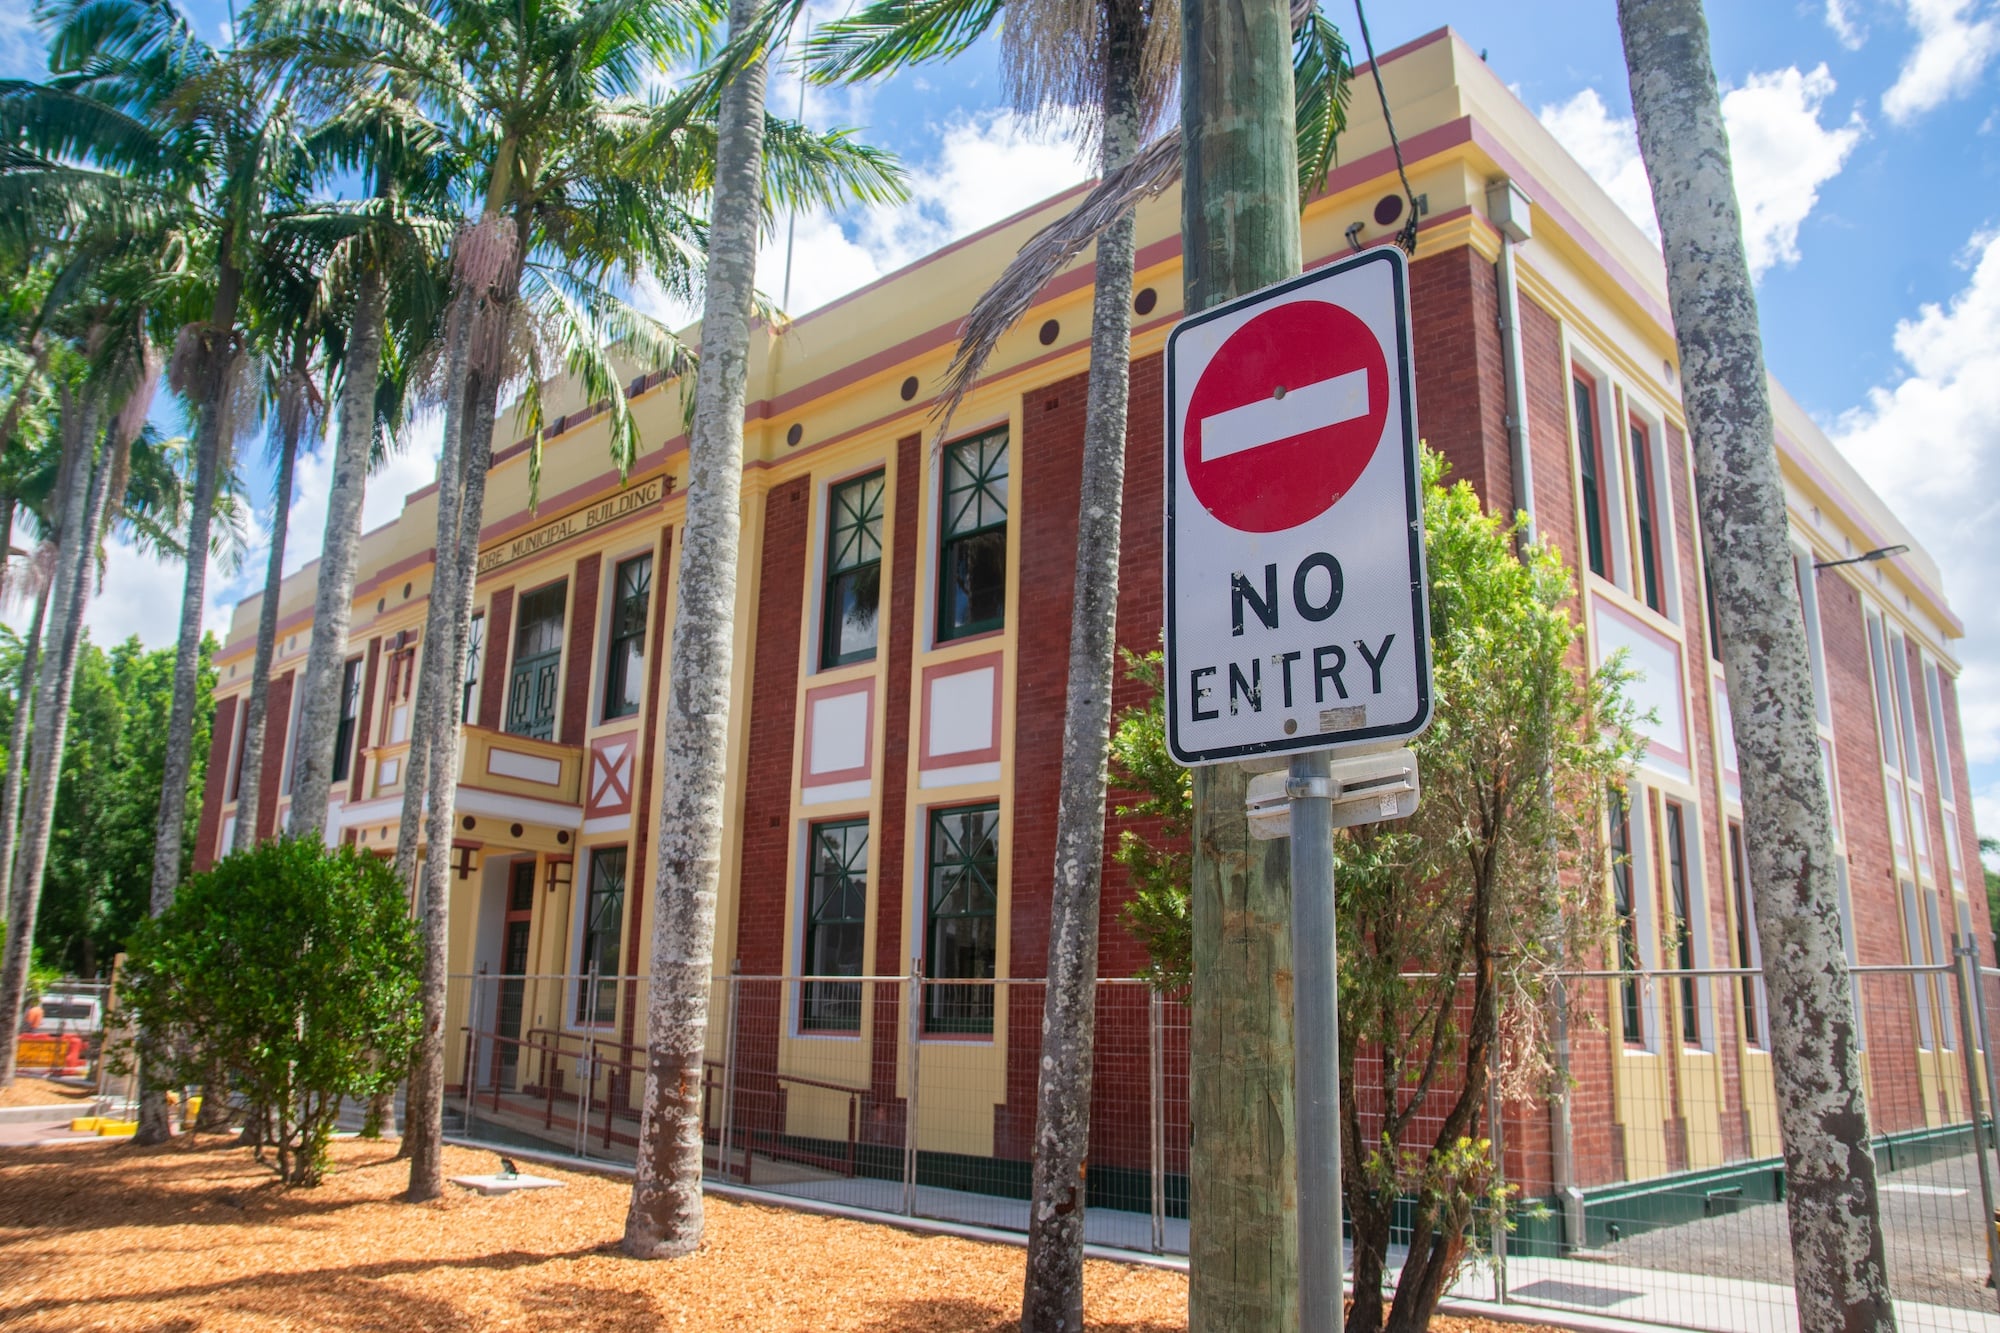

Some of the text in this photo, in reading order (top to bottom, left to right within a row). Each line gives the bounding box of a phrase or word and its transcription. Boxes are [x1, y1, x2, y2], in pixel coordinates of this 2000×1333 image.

[478, 483, 657, 572] ORE MUNICIPAL BUILDING
[1230, 551, 1344, 637] NO
[1190, 633, 1396, 722] ENTRY
